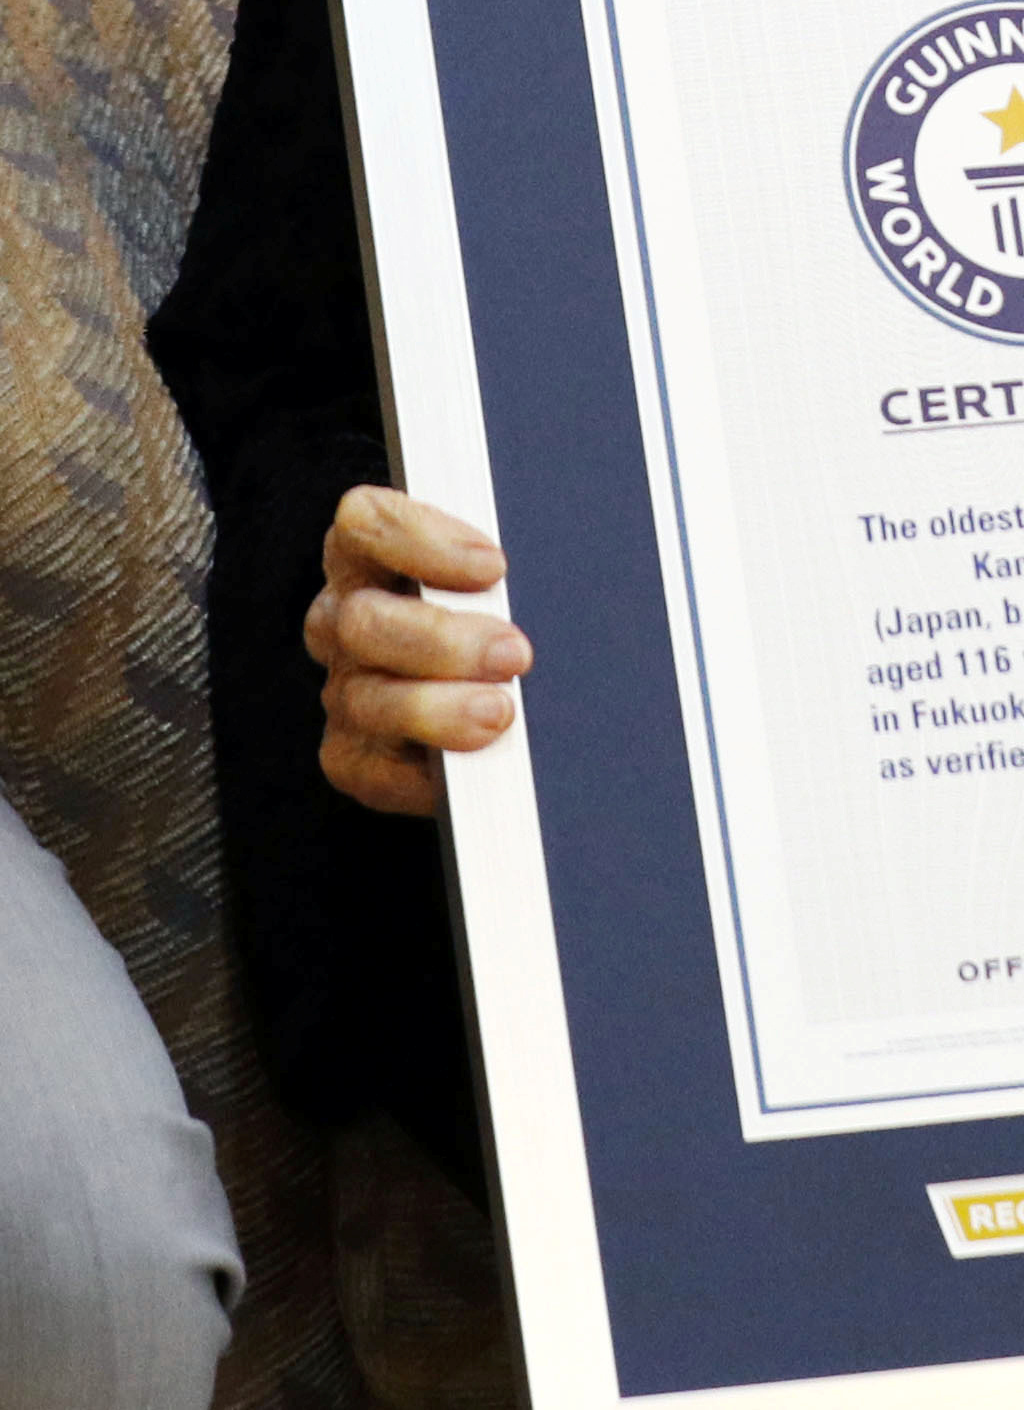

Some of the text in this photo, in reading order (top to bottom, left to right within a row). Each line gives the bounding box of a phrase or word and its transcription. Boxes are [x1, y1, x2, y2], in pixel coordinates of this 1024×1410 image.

[865, 157, 1004, 318] WORLD
[856, 513, 918, 543] The
[874, 606, 992, 644] (Japan,
[867, 650, 943, 692] aged
[955, 645, 1012, 677] 116
[871, 703, 900, 733] in
[880, 756, 915, 780] as
